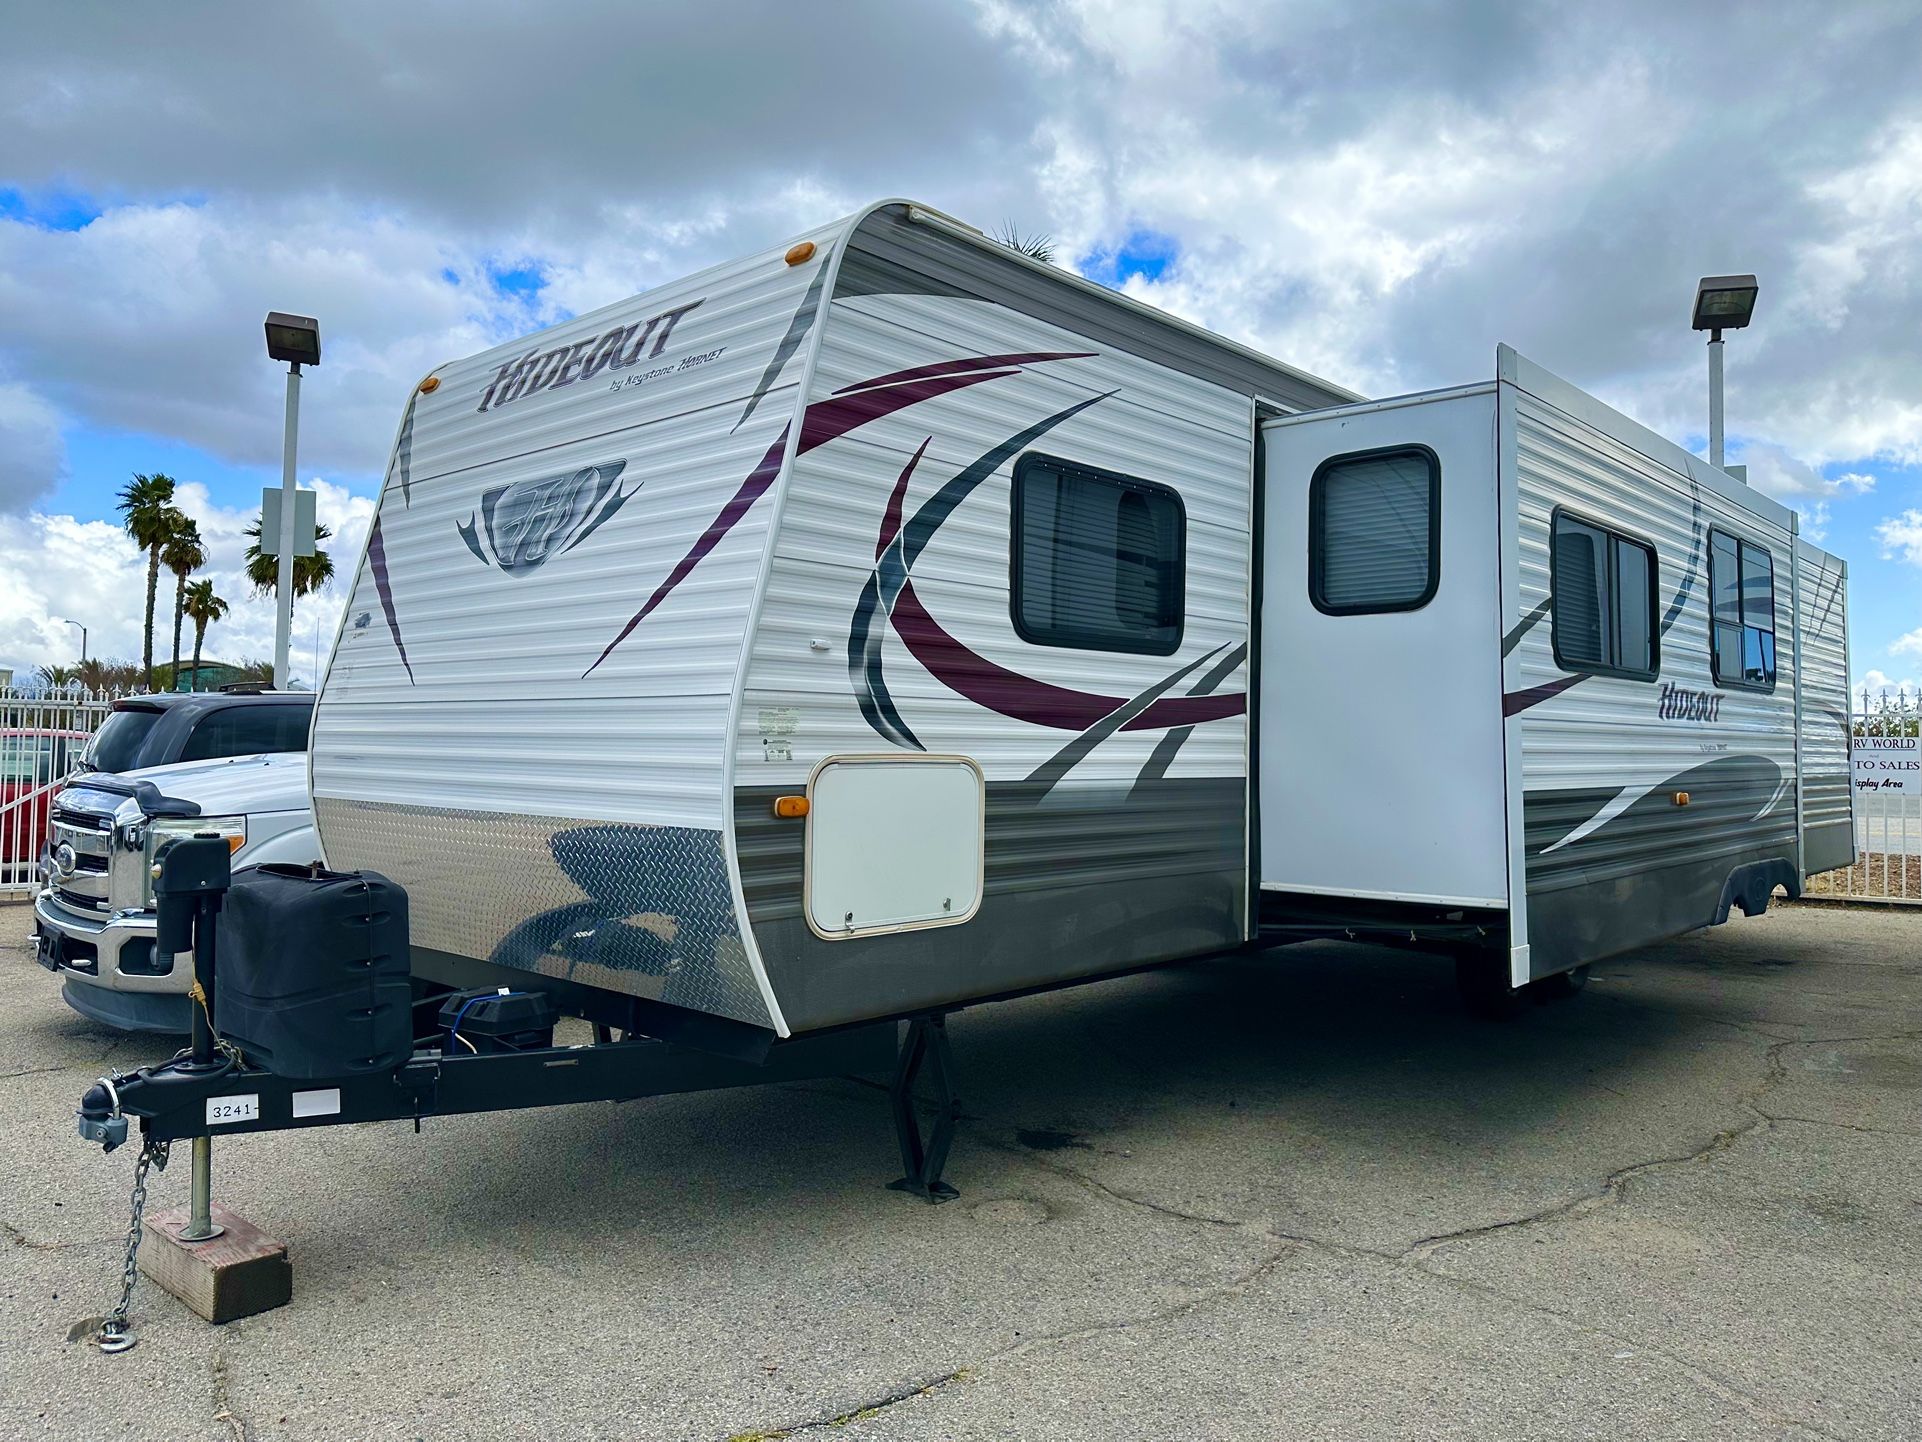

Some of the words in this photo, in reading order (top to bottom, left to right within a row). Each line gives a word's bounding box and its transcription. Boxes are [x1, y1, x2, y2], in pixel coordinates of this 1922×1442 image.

[476, 296, 707, 414] HIDEOUT
[609, 379, 624, 392] by
[624, 365, 675, 386] Keystone
[677, 346, 728, 372] HORNET
[1657, 680, 1726, 723] HIDEOUT
[1853, 738, 1868, 749] RV
[1872, 738, 1916, 749] WORLD
[1879, 760, 1920, 771] SALES
[1881, 778, 1903, 789] Area
